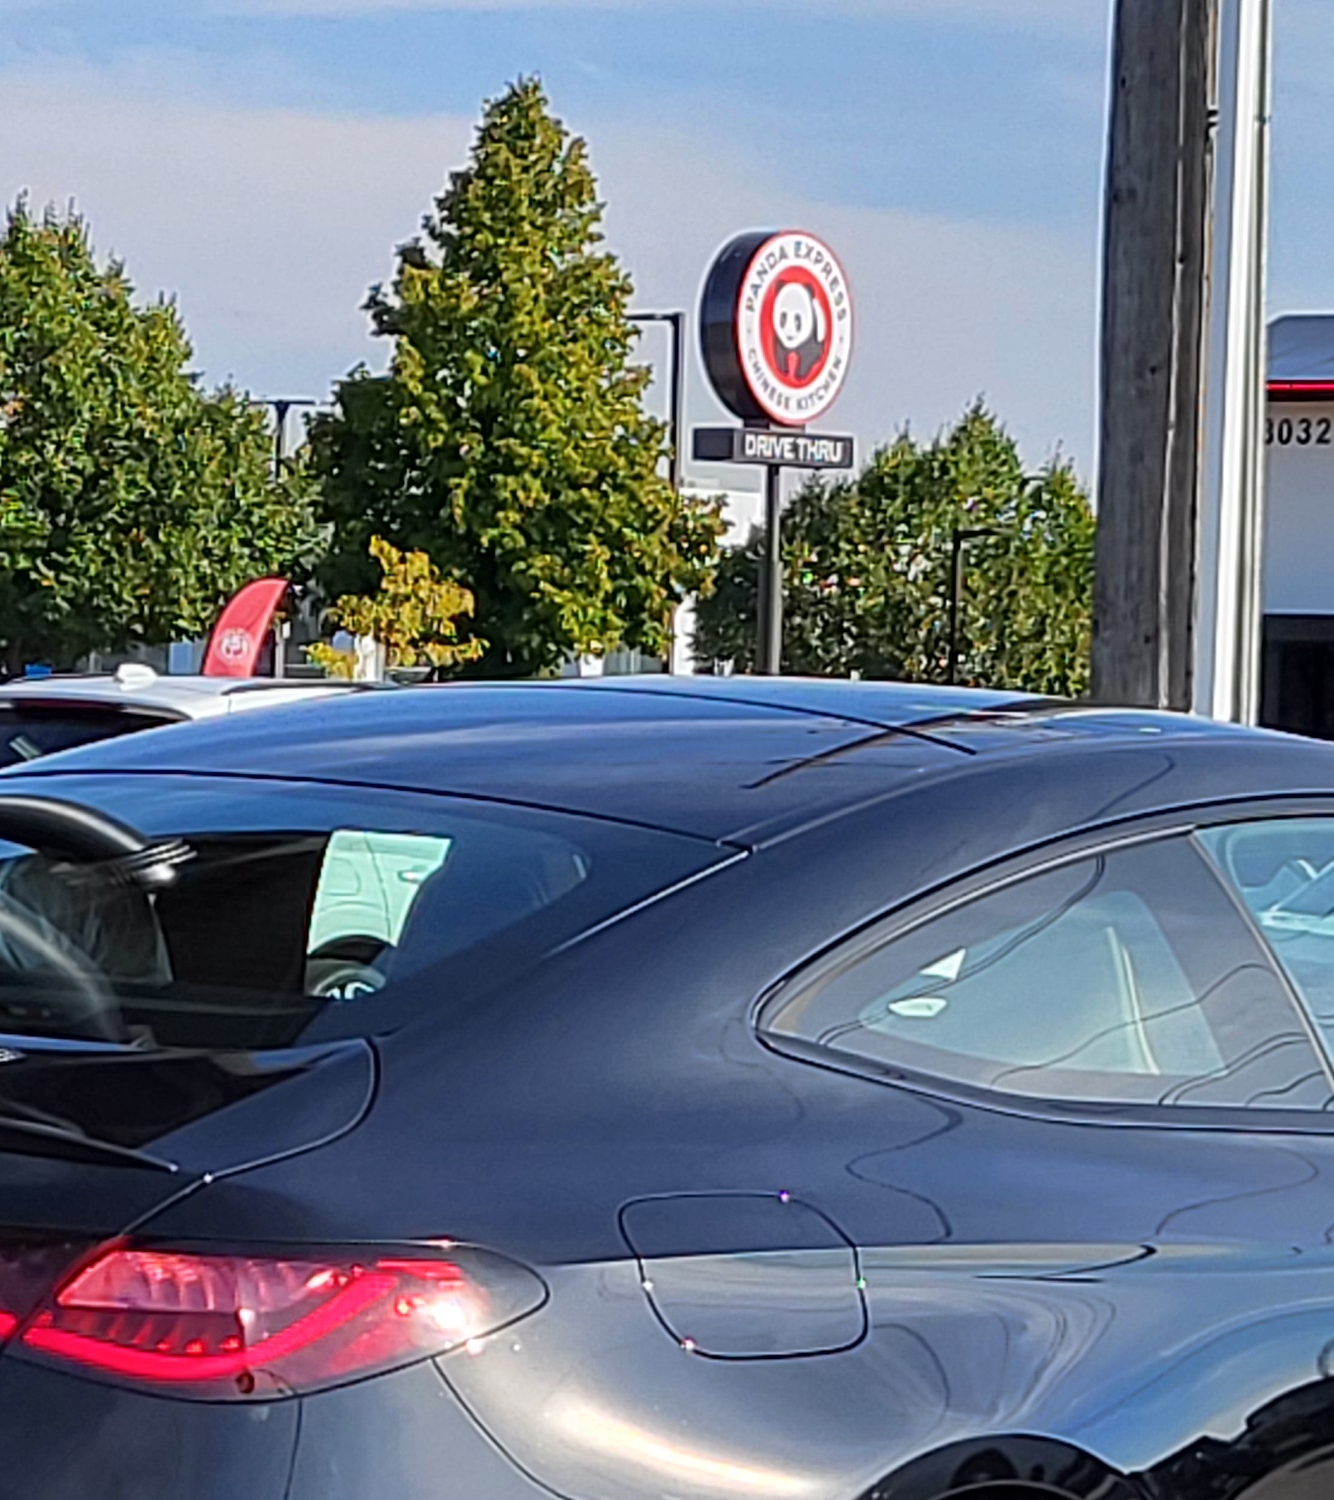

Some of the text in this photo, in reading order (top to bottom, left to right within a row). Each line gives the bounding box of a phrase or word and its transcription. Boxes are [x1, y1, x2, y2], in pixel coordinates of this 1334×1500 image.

[745, 241, 847, 321] PANDA EXPRESS
[747, 347, 791, 410] CHINESE
[745, 434, 843, 462] DRIVE THRU
